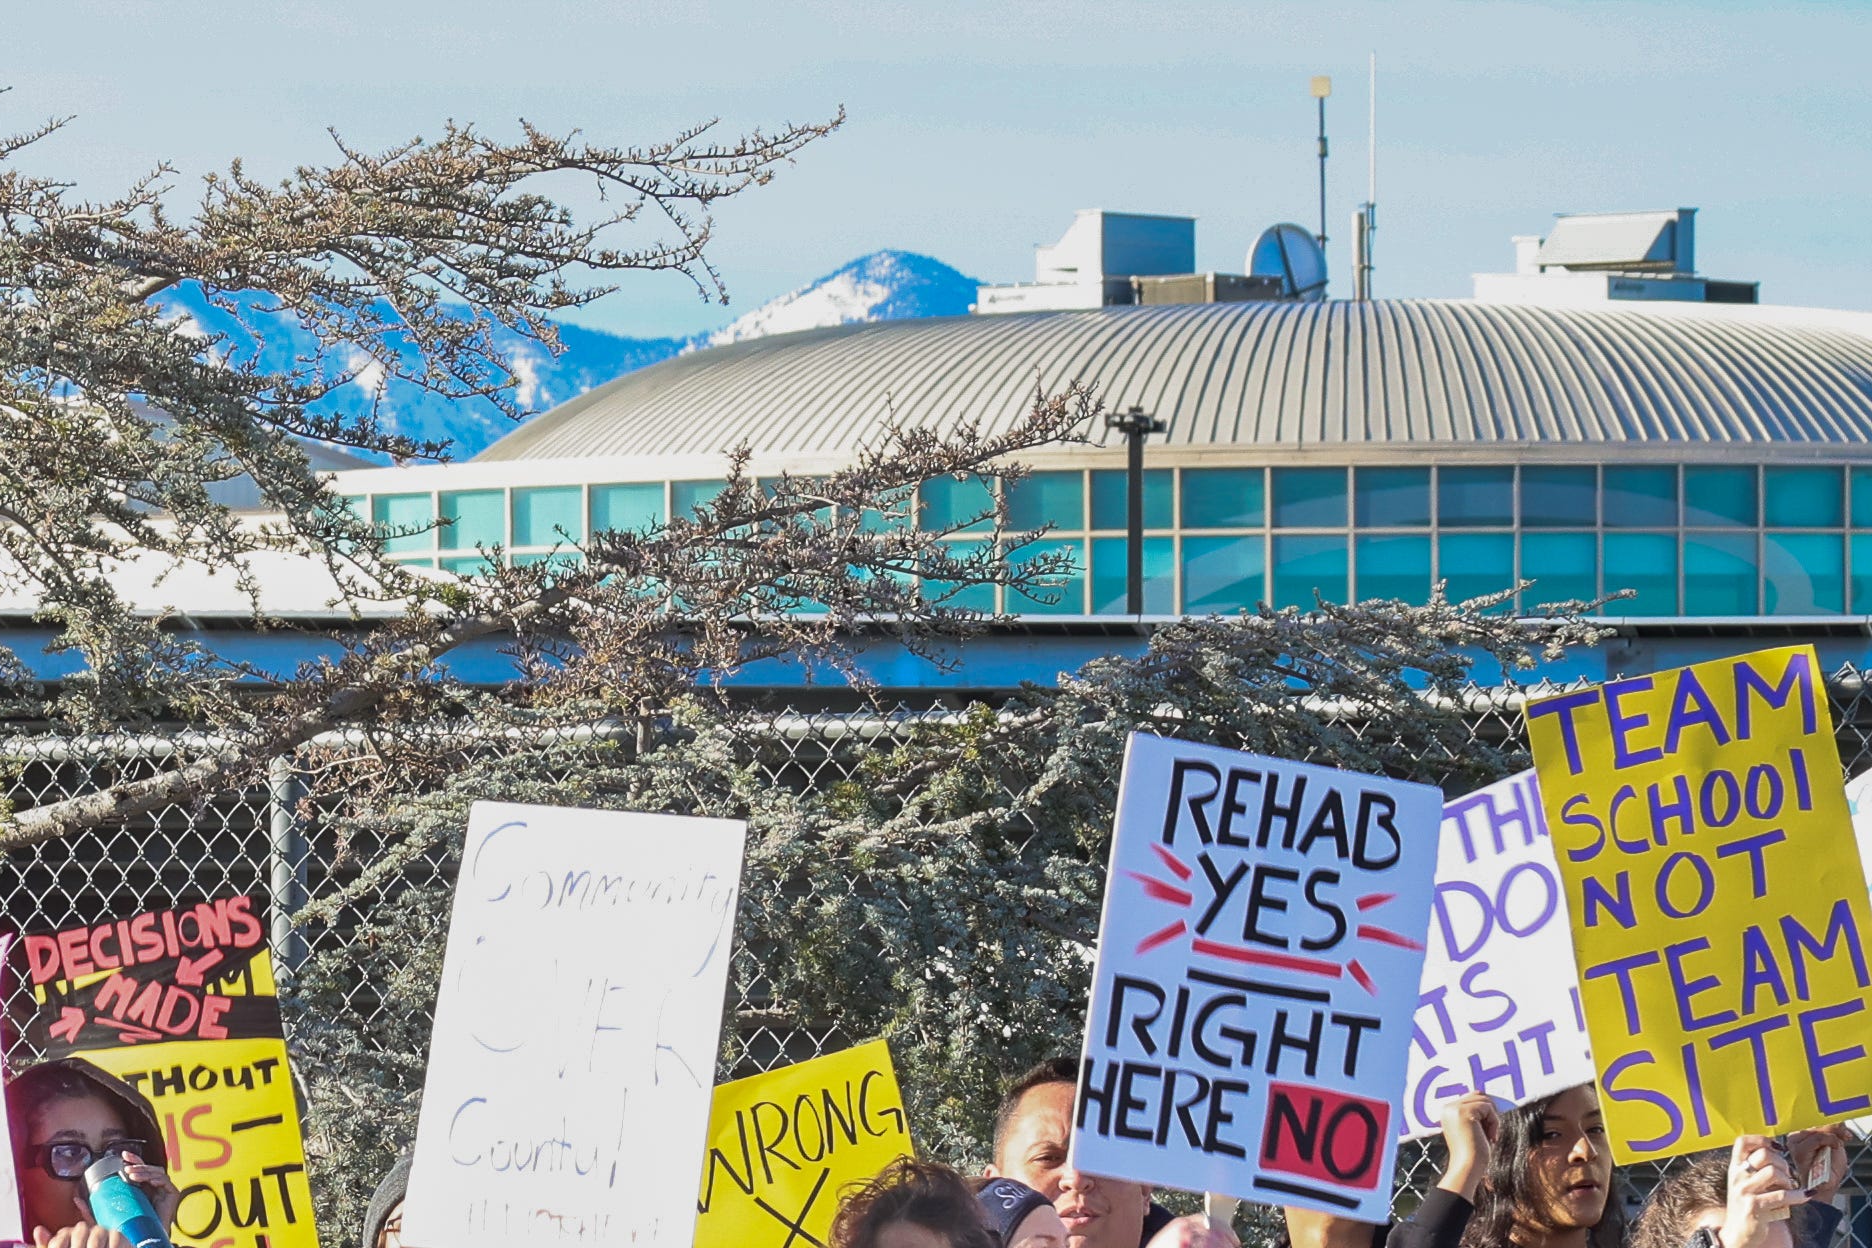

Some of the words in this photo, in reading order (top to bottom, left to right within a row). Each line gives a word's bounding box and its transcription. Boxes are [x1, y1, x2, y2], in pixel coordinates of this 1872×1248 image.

[1528, 653, 1818, 776] TEAM
[1161, 756, 1402, 871] REHAB
[1194, 851, 1348, 952] YES
[1433, 861, 1559, 963] DO
[1581, 828, 1788, 930] NOT
[23, 894, 263, 985] DECISIONS
[1583, 898, 1871, 1036] TEAM
[93, 972, 232, 1041] MADE
[1104, 972, 1383, 1078] RIGHT
[121, 1057, 280, 1098] THOUT
[1075, 1057, 1250, 1159] HERE
[1263, 1086, 1380, 1182] NO
[1600, 997, 1871, 1153] SITE
[696, 1069, 905, 1215] WRONG
[172, 1163, 304, 1241] OUT
